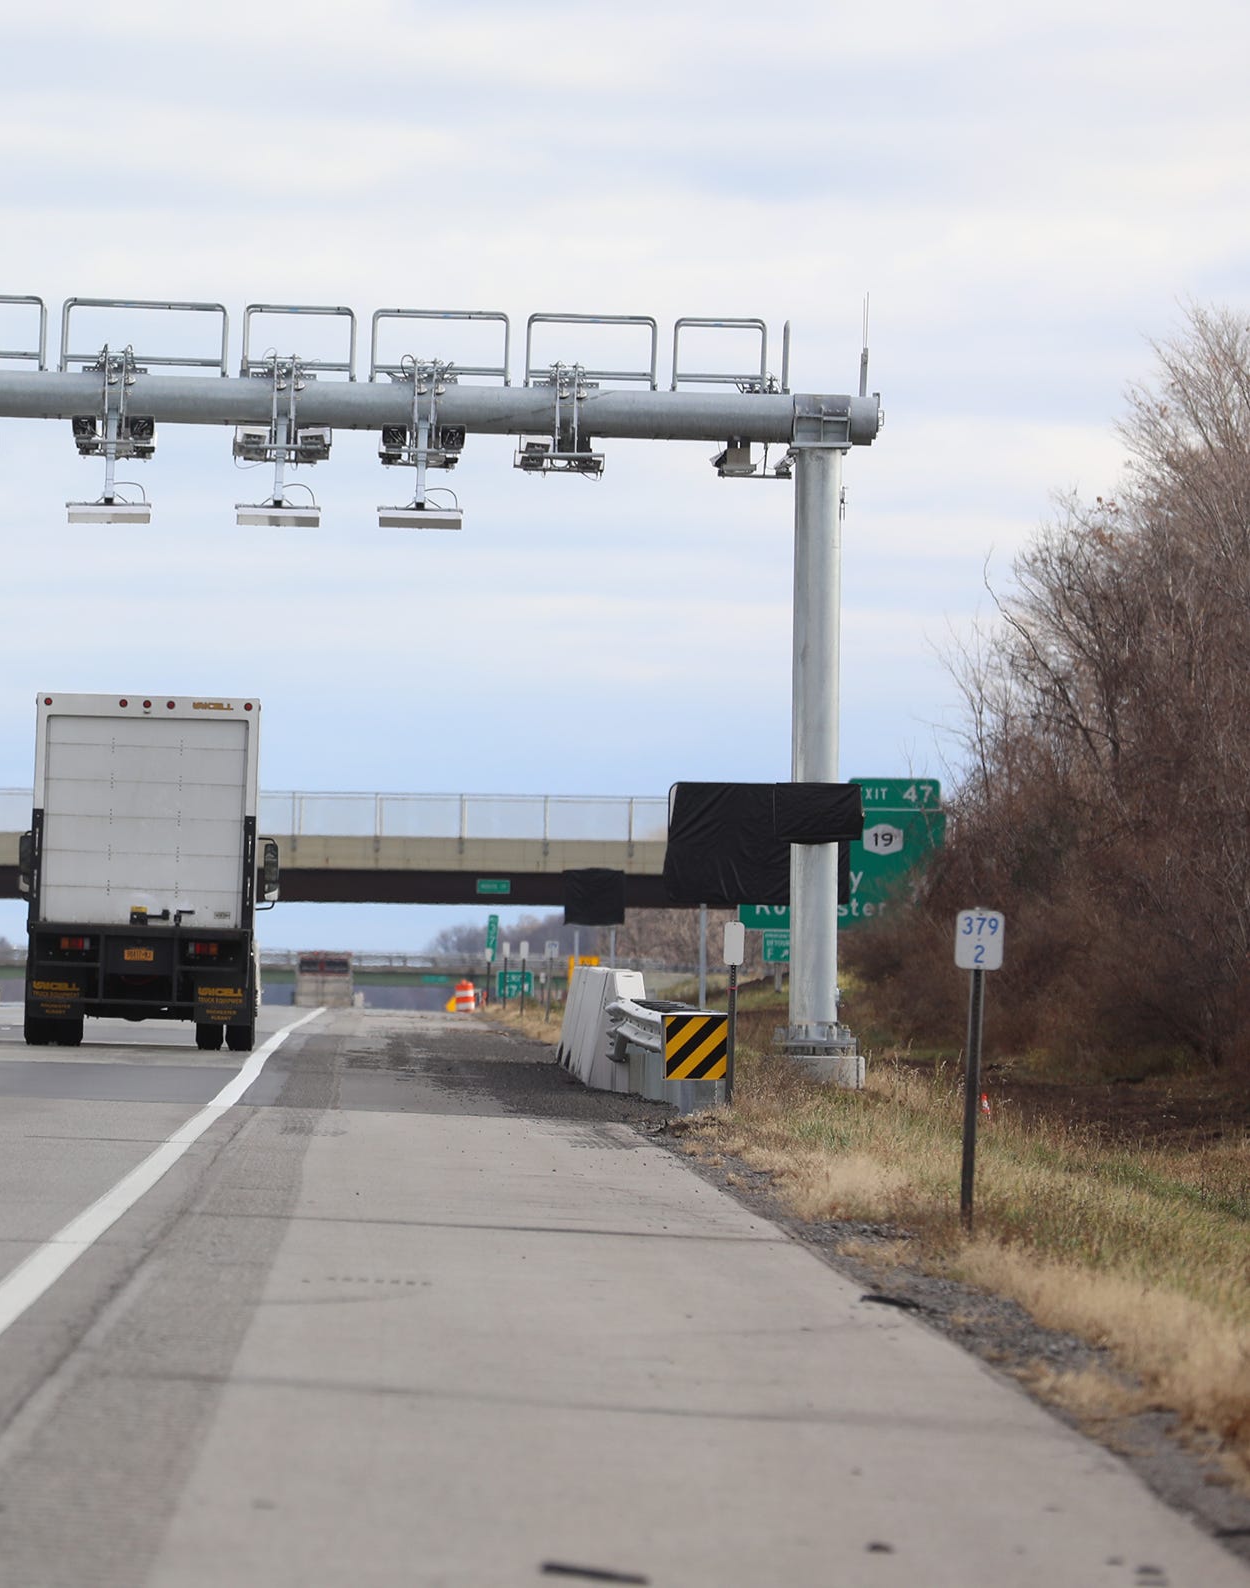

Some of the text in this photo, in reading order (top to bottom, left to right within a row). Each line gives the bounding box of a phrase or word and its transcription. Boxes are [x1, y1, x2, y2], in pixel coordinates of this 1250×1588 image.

[903, 785, 933, 803] 47
[873, 833, 893, 848] 19
[755, 900, 886, 917] Roster
[961, 916, 999, 936] 379
[973, 944, 986, 964] 2
